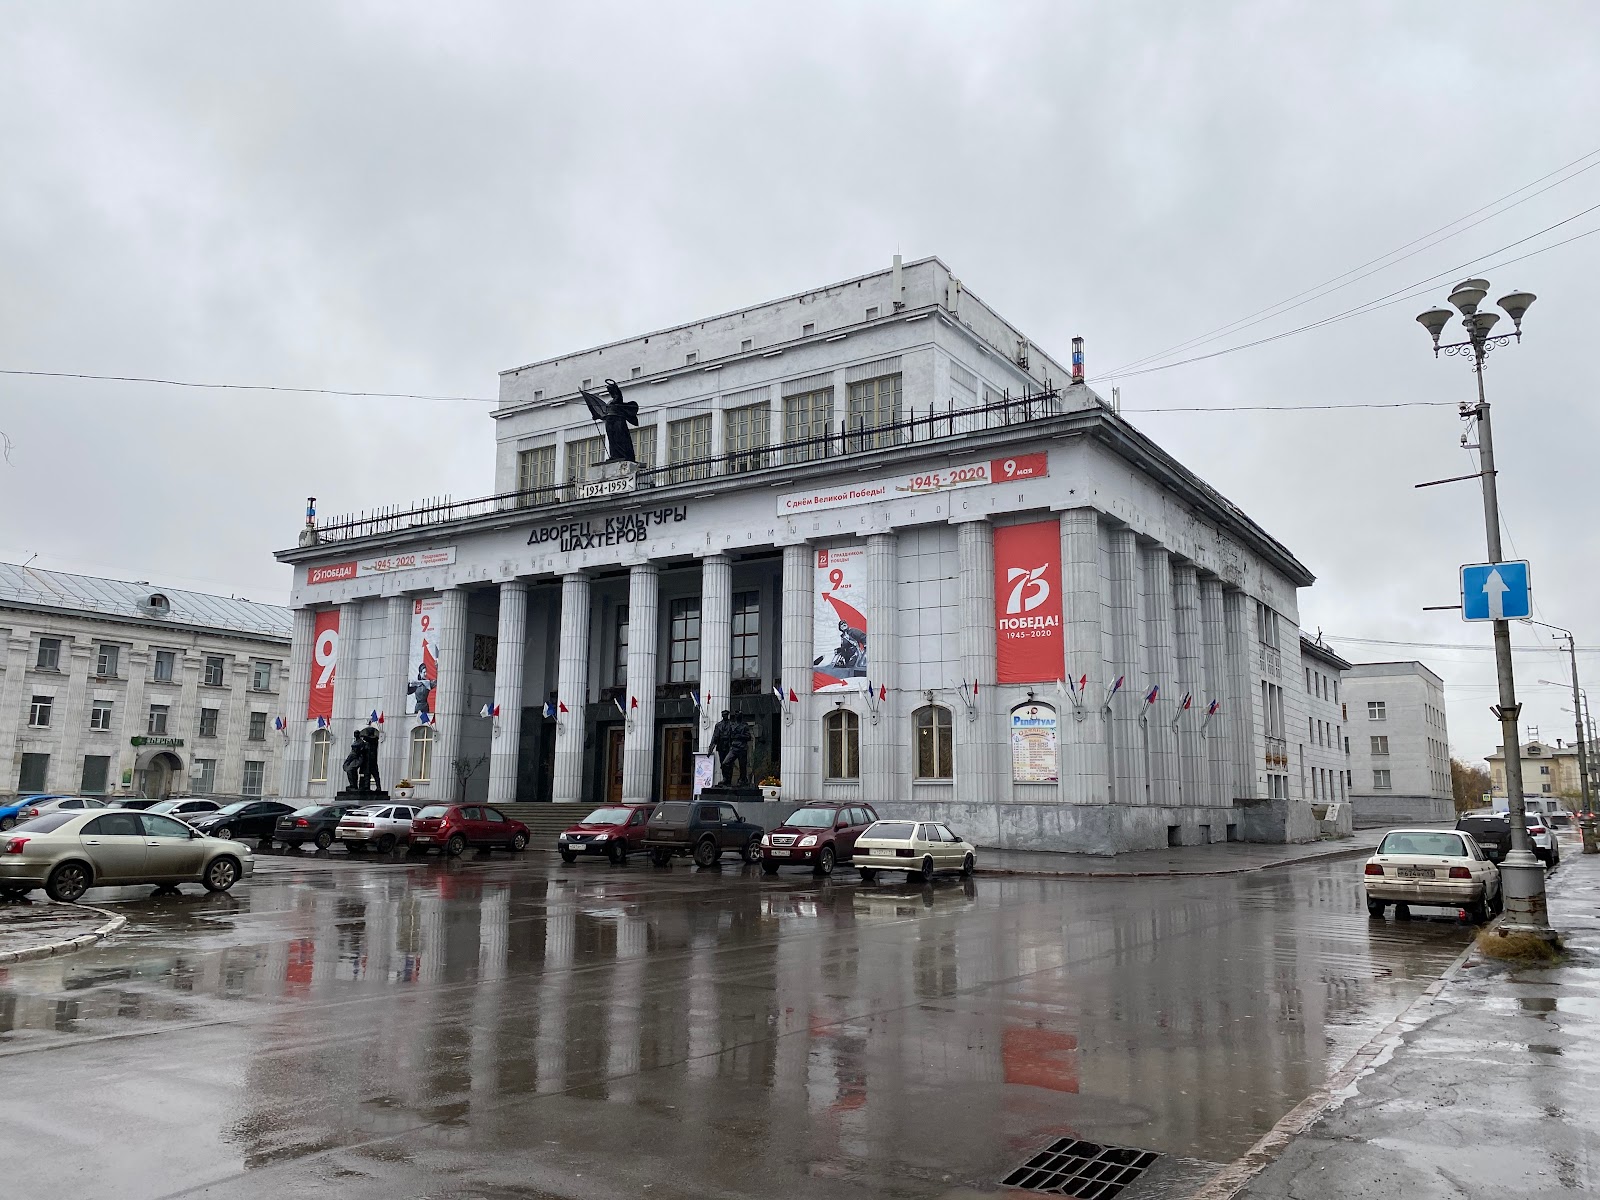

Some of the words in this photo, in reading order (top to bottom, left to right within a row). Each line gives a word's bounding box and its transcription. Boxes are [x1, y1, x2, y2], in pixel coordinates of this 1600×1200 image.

[1003, 459, 1017, 477] 9
[1017, 466, 1034, 476] мая
[786, 500, 792, 508] С
[793, 498, 813, 508] днём
[814, 492, 848, 503] Великой
[849, 486, 886, 499] Победы!
[527, 521, 591, 546] ДВОРЕЦ
[605, 505, 687, 534] КУЛЬТУРЫ
[560, 527, 648, 553] ШАХТЕРОВ
[321, 567, 352, 579] ПОБЕДА!
[829, 568, 844, 591] 9
[1006, 562, 1050, 615] 75
[421, 615, 430, 633] 9
[999, 615, 1059, 630] ПОБЕДА!
[315, 629, 339, 684] 9
